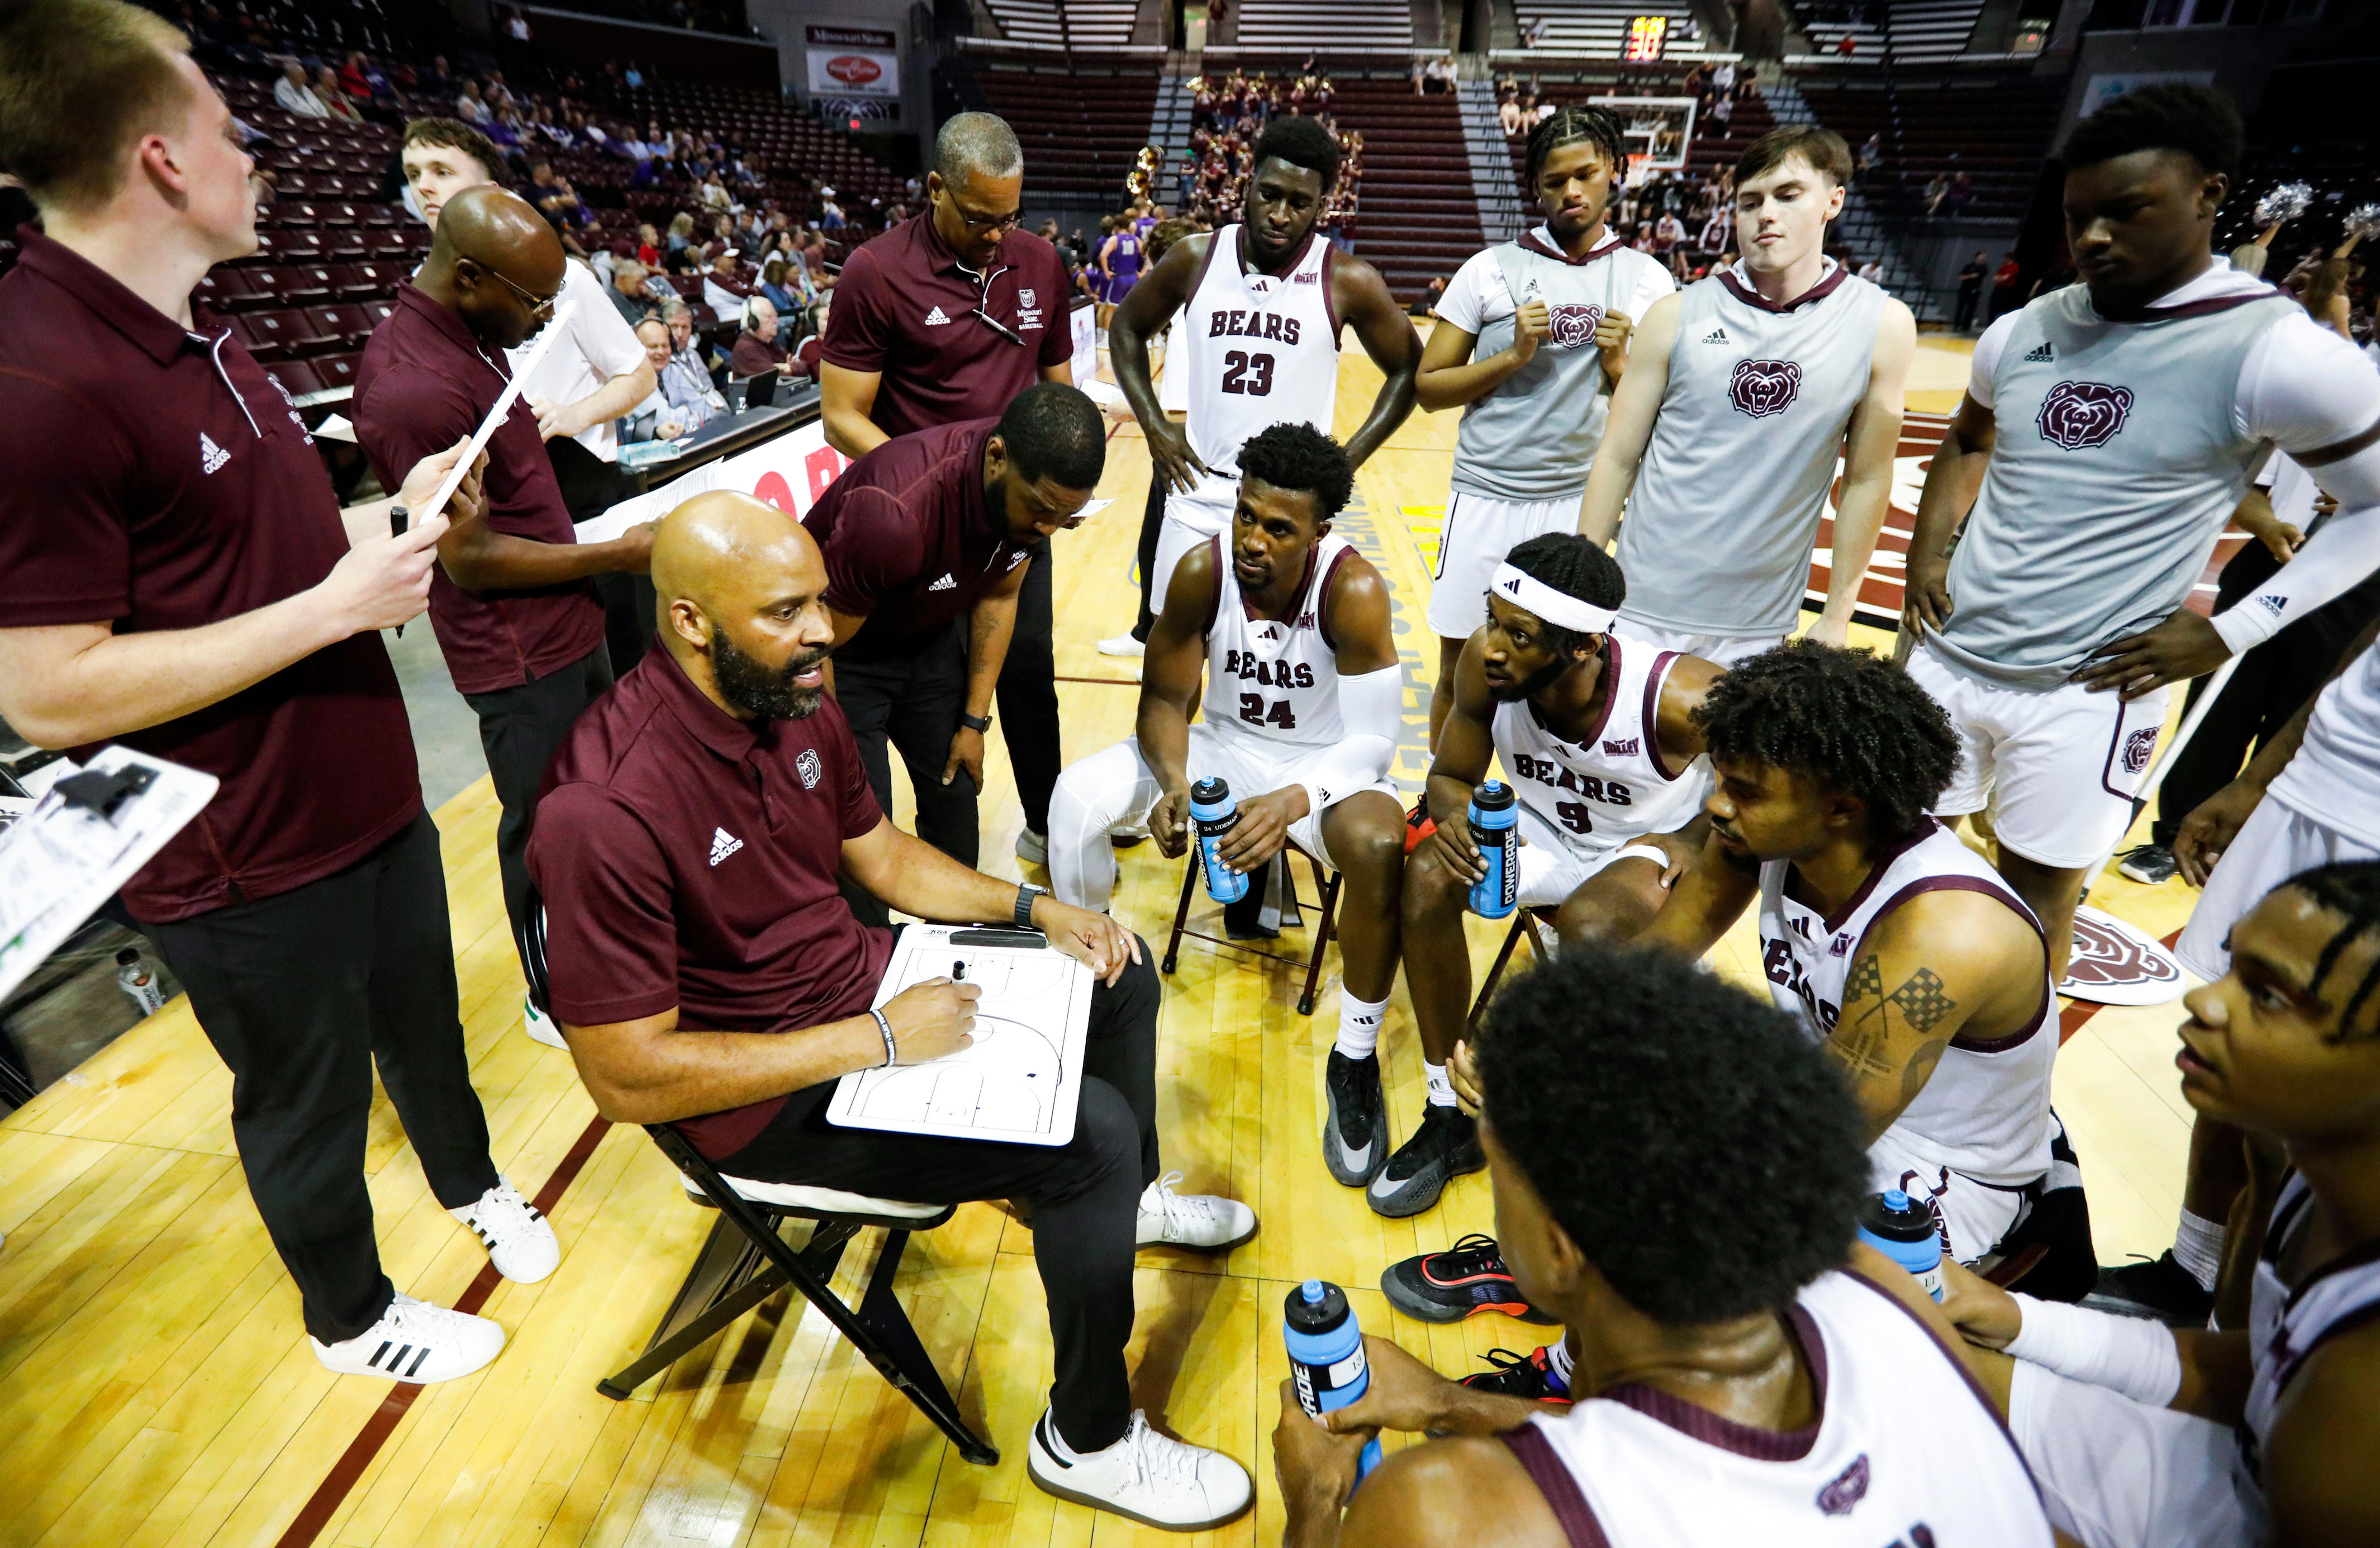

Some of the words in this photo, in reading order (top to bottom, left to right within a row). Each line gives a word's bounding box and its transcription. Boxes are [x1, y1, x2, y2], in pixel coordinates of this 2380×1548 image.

[1627, 34, 1660, 61] 30
[925, 317, 951, 326] adidas
[1017, 308, 1042, 317] Missouri
[1209, 310, 1301, 346] BEARS
[2024, 354, 2054, 363] adidas
[1222, 350, 1275, 396] 23
[204, 449, 231, 474] adidas
[928, 581, 957, 591] adidas
[2255, 596, 2282, 618] adidas
[1224, 649, 1315, 689] BEARS
[1239, 692, 1296, 729] 24
[1602, 737, 1640, 754] VALLEY
[1513, 753, 1632, 806] BEARS
[1556, 801, 1593, 834] 9
[710, 839, 744, 866] adidas
[1191, 819, 1210, 889] POWERADE
[1504, 828, 1516, 905] POWERADE
[882, 1024, 891, 1038] PLAY
[1352, 1354, 1362, 1371] 13
